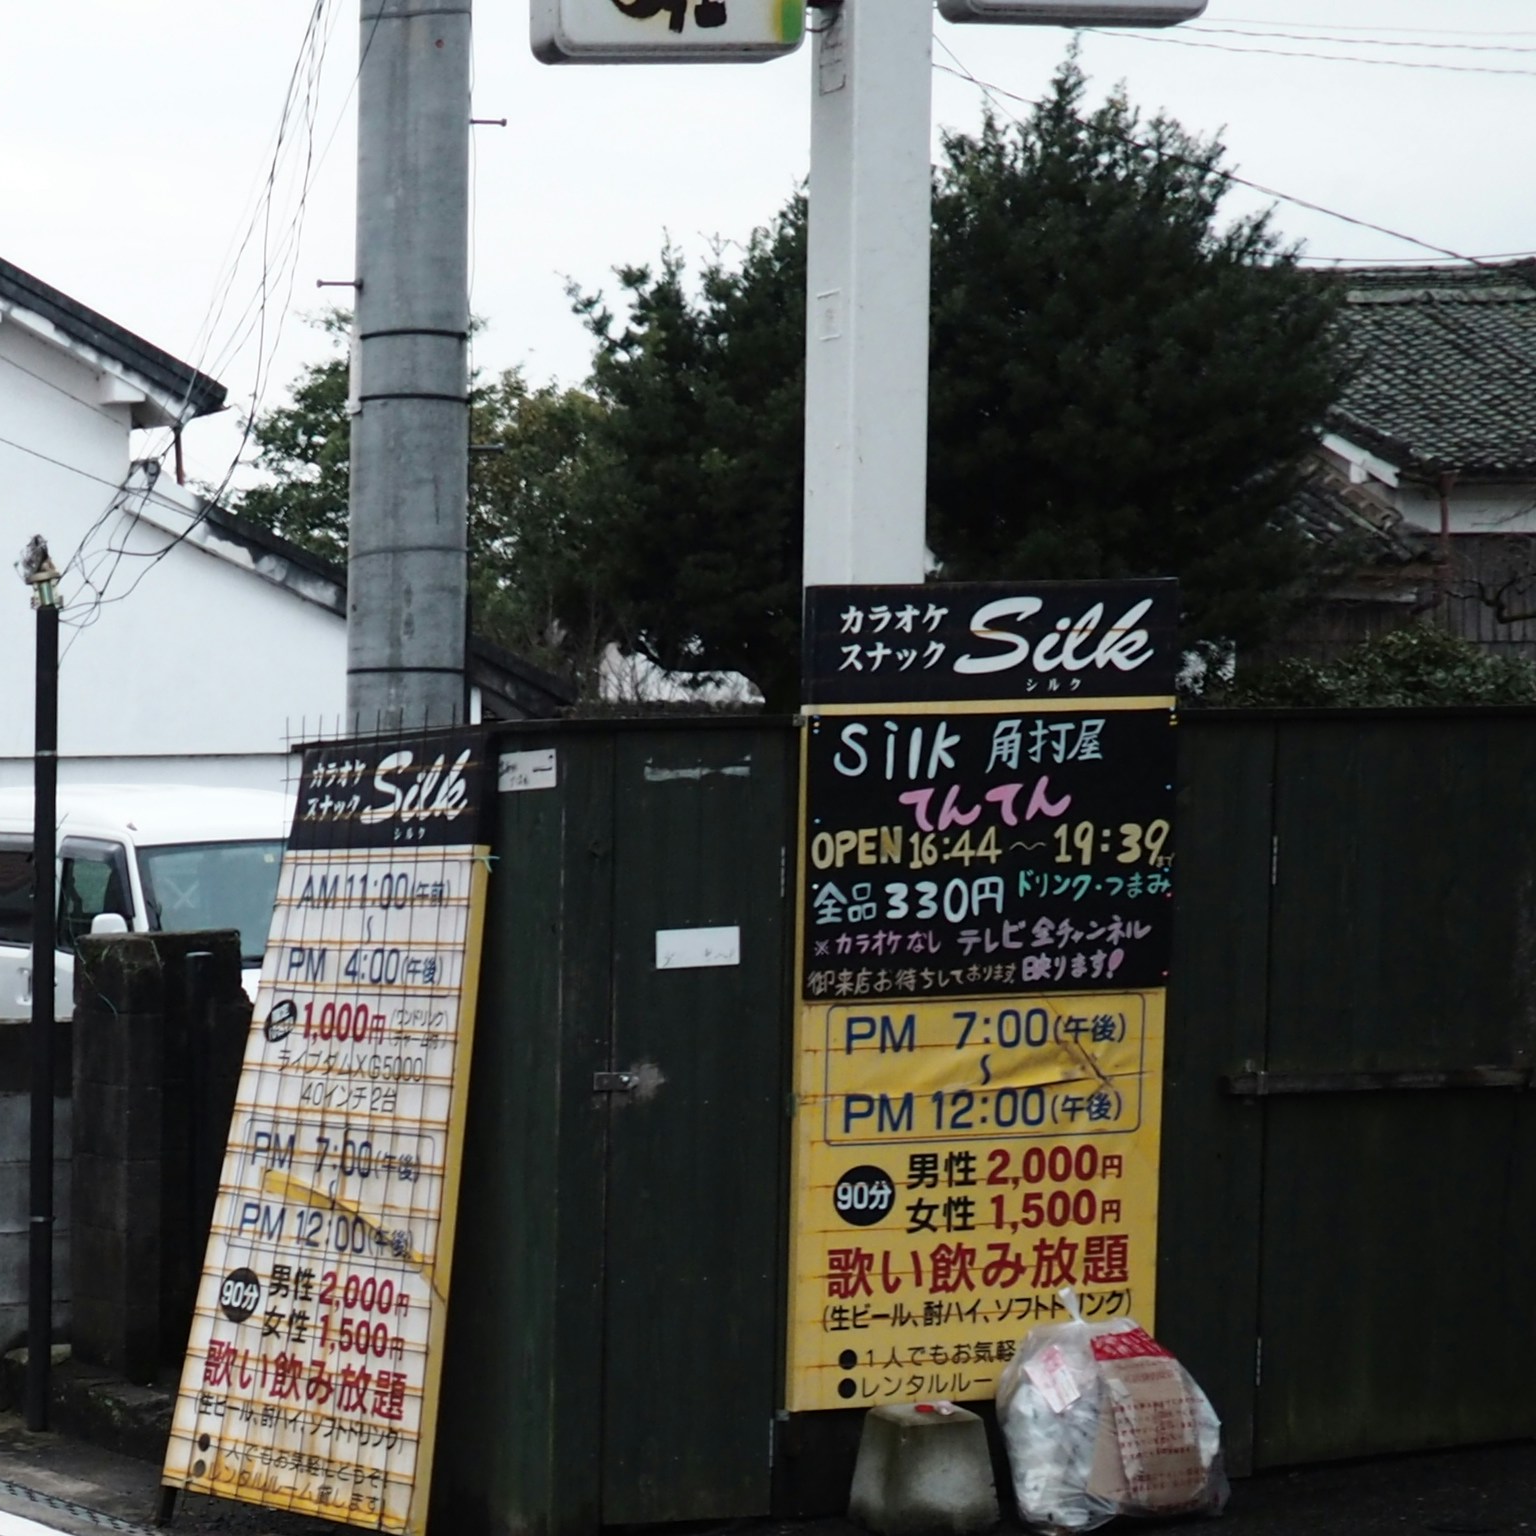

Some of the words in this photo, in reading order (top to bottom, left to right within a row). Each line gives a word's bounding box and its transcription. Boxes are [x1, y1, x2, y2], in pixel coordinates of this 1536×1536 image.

[838, 602, 950, 636] カラオケ
[953, 596, 1155, 675] Silk
[837, 640, 948, 673] スナック
[833, 719, 962, 781] Silk
[985, 717, 1107, 775] 角打屋
[309, 758, 367, 789] カラオケ
[359, 748, 472, 825] Silk
[303, 793, 361, 822] スナック
[898, 775, 1073, 833] てんてん
[298, 876, 339, 910] AM
[286, 947, 326, 983] PM
[844, 1013, 917, 1053] PM
[842, 1094, 914, 1134] PM
[250, 1131, 295, 1170] PM
[905, 1151, 978, 1191] 男性
[836, 1179, 894, 1212] 90分
[239, 1203, 285, 1241] PM
[905, 1198, 977, 1236] 女性
[268, 1264, 316, 1303] 男性
[826, 1233, 1131, 1300] 歌い飲み放題
[220, 1280, 261, 1311] 90分
[261, 1307, 309, 1345] 女性
[203, 1339, 409, 1421] 歌い飲み放題
